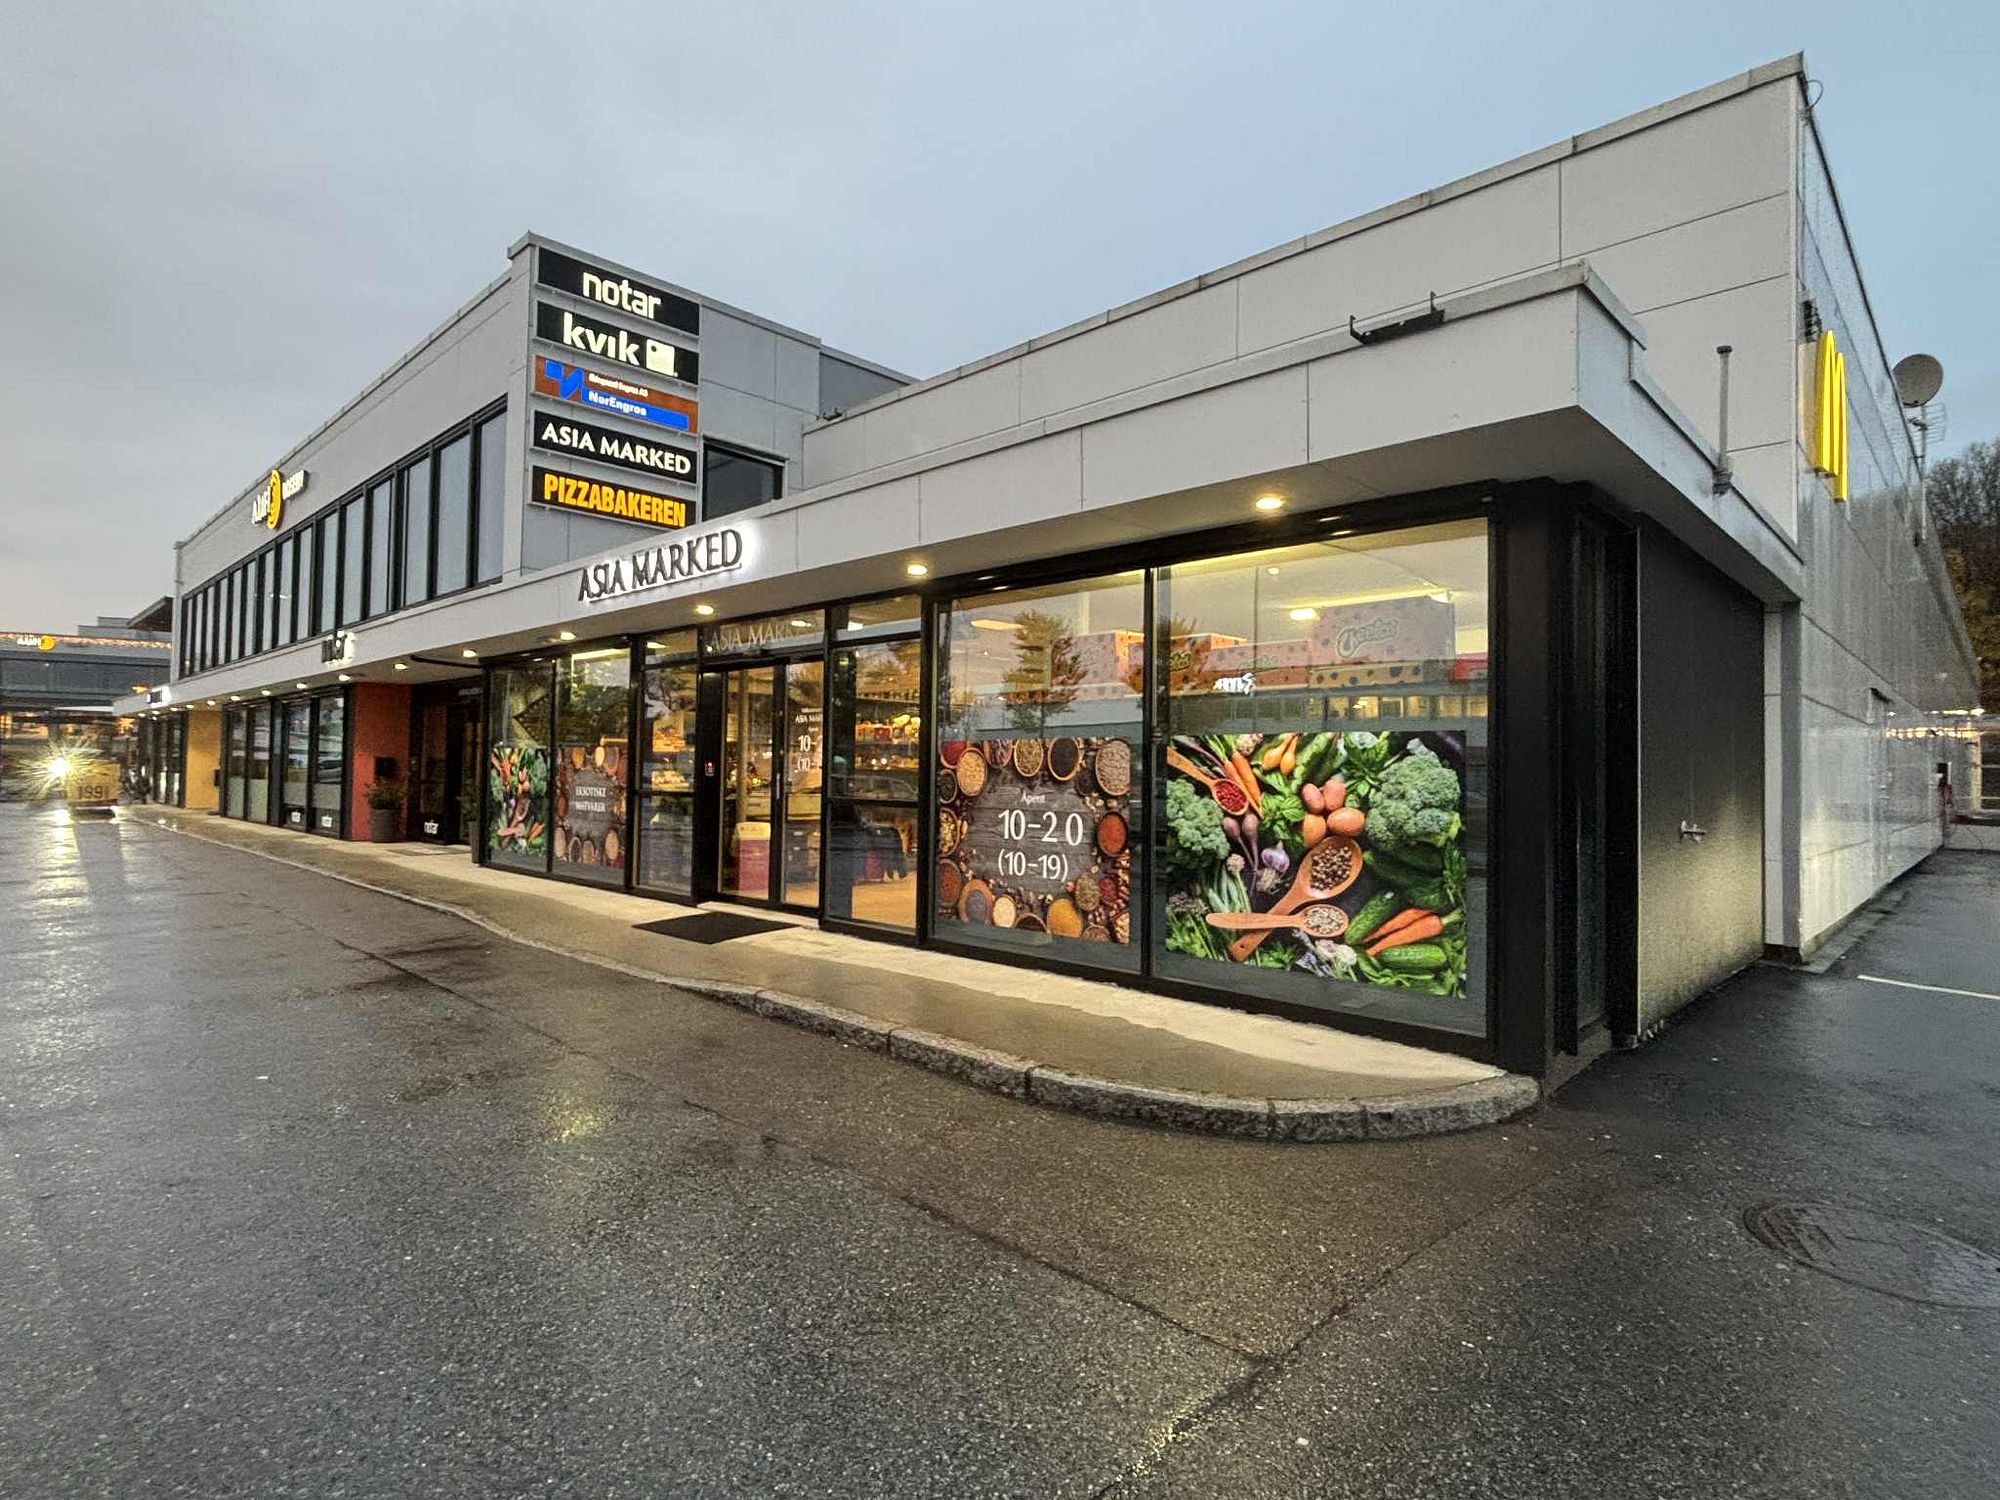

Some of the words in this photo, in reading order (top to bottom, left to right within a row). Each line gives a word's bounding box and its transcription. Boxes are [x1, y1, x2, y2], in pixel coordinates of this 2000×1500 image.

[583, 272, 661, 319] notar
[563, 312, 640, 366] kvik
[588, 390, 647, 416] NorEngros
[541, 422, 595, 453] ASIA
[600, 436, 691, 474] MARKED
[544, 473, 686, 528] PIZZABAKEREN
[578, 559, 627, 602] ASIA
[632, 529, 743, 589] MARKED
[748, 614, 812, 645] MARK
[998, 809, 1084, 846] 10-20
[998, 848, 1069, 882] (10-19)
